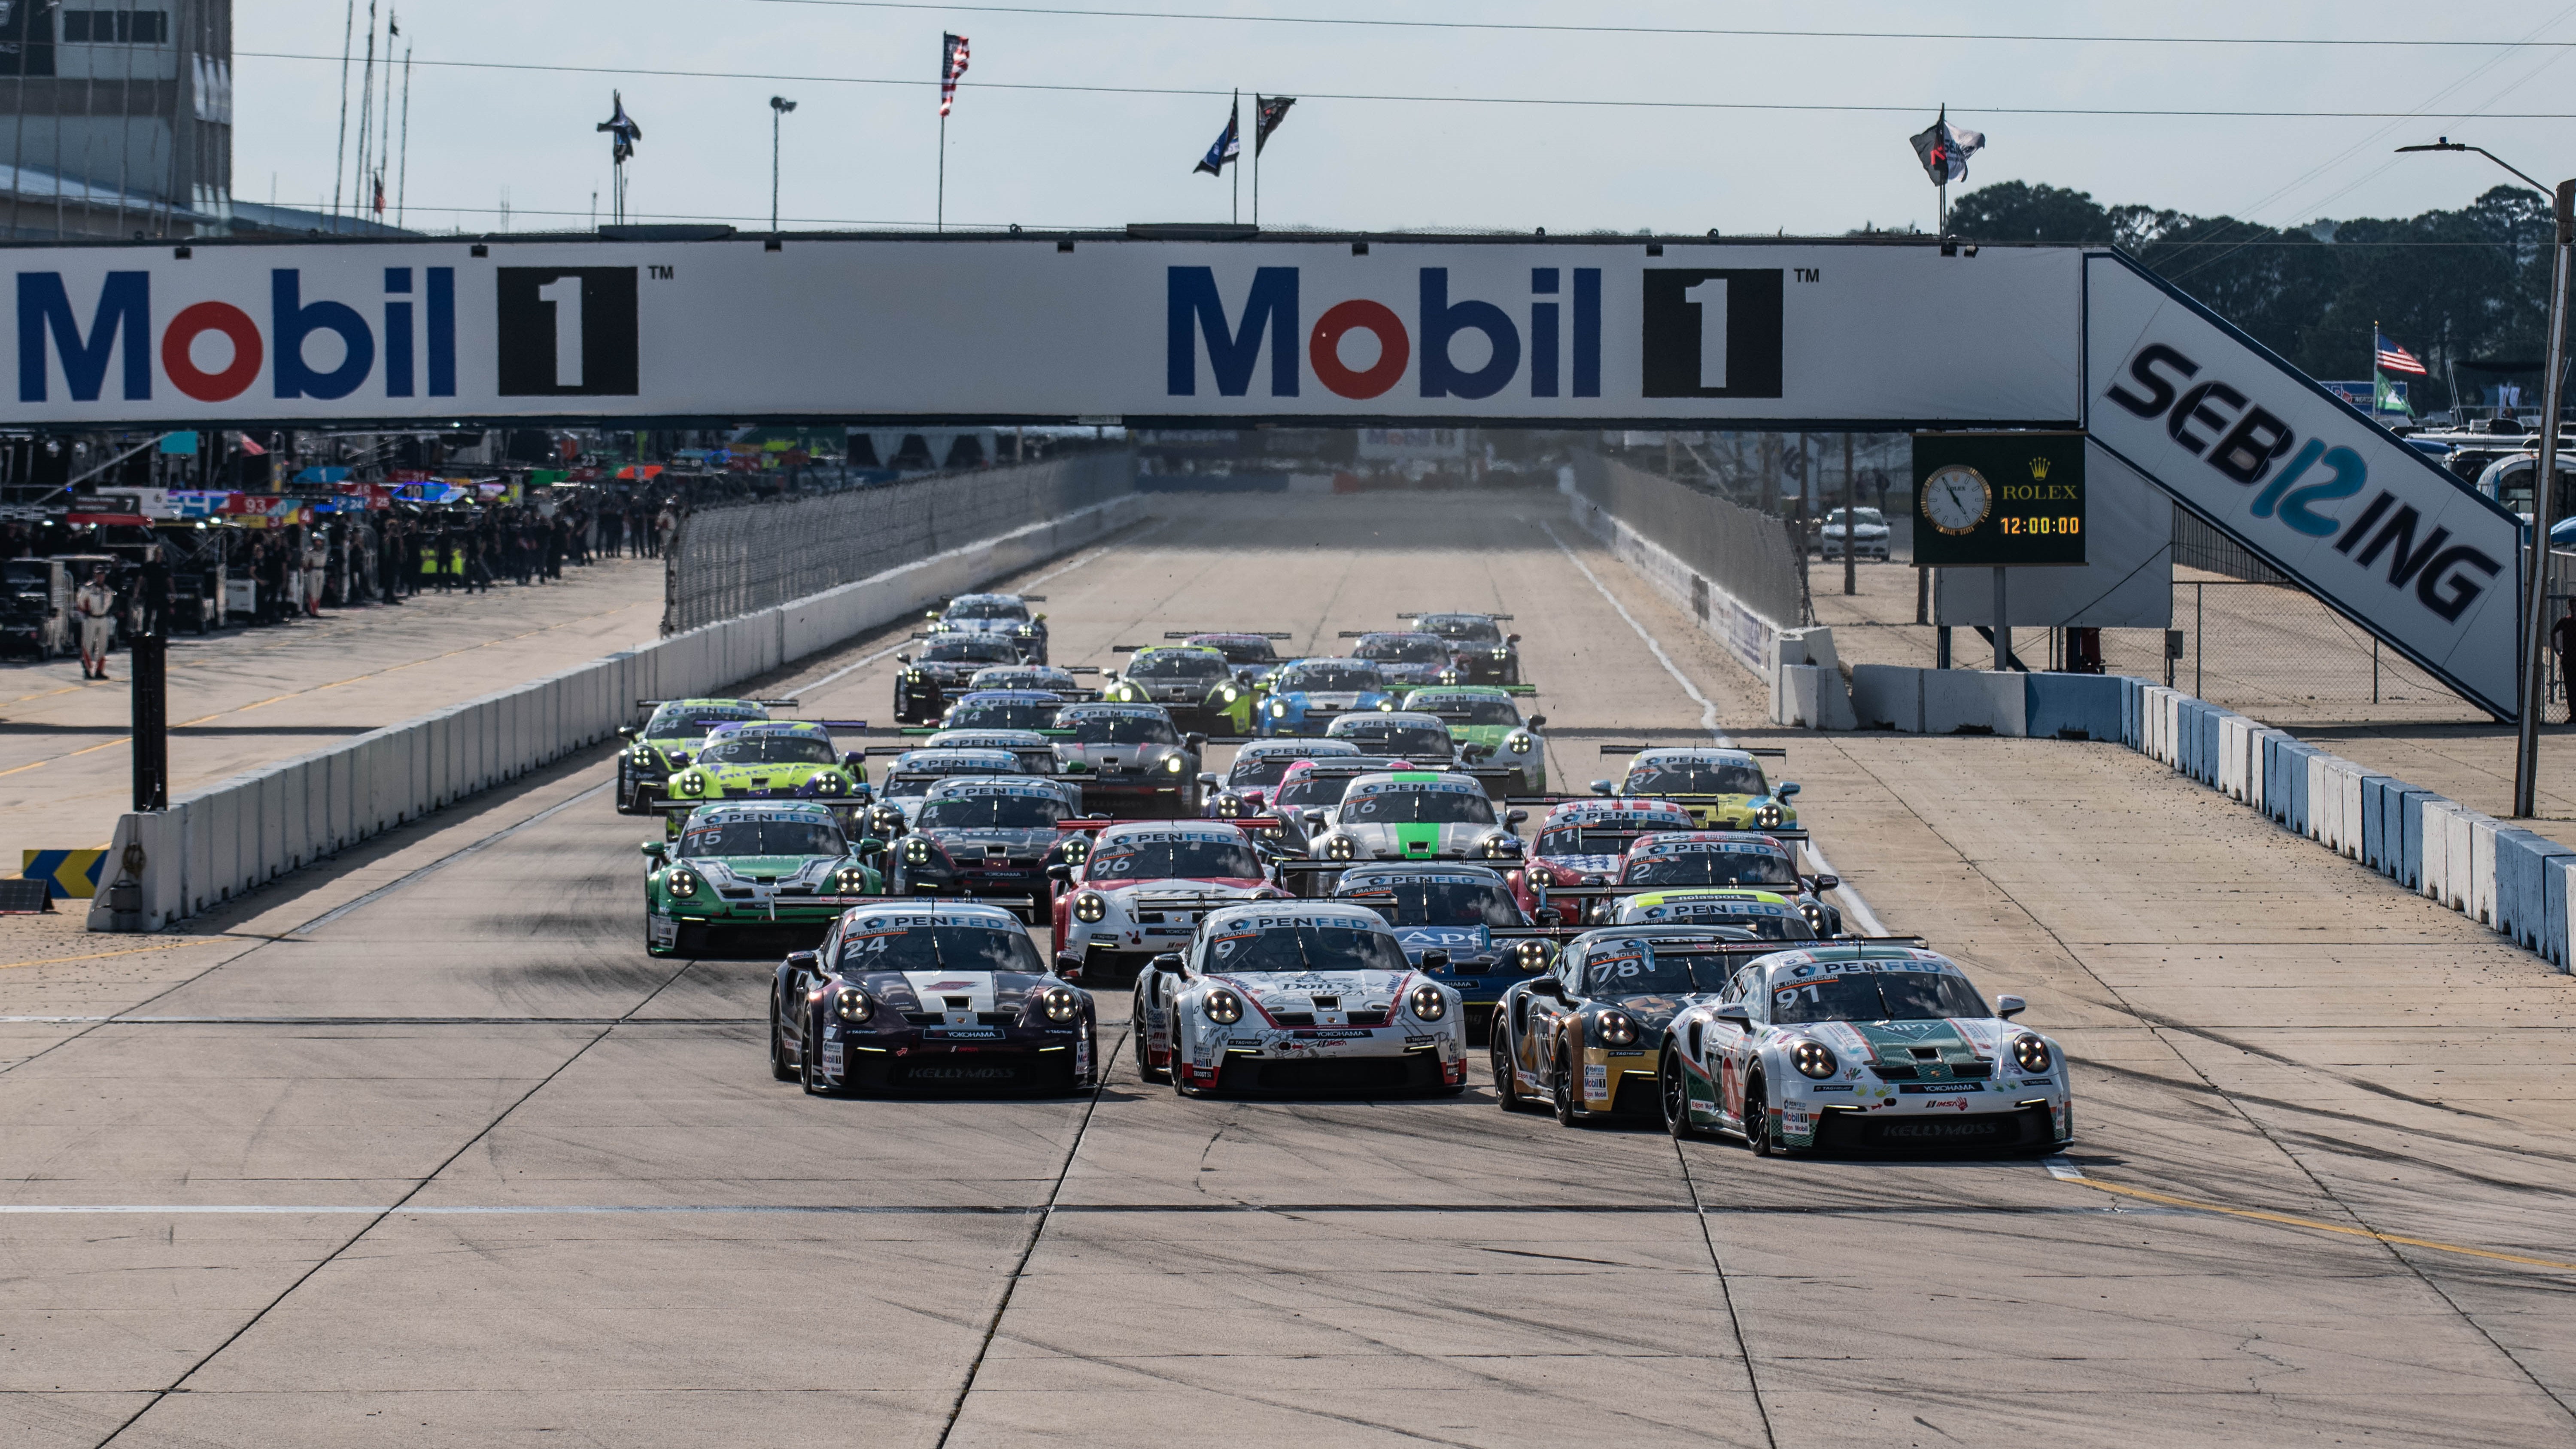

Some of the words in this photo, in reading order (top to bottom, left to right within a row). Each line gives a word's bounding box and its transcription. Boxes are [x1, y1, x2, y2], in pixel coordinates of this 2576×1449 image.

[649, 267, 673, 280] TM
[1794, 269, 1820, 283] TM
[16, 266, 457, 403] Mobil
[538, 276, 583, 387] 1
[1166, 267, 1601, 400] Mobil
[1685, 278, 1728, 389] 1
[2002, 486, 2078, 500] ROLEX
[244, 499, 266, 513] 93
[2001, 517, 2079, 534] 12:00:00
[928, 759, 1007, 769] PENFED
[1666, 757, 1744, 766] PENFED
[965, 787, 1050, 798] PENFED
[1385, 784, 1469, 793] PENFED
[923, 806, 940, 819] 4
[1345, 800, 1377, 816] 16
[729, 813, 819, 823] PENFED
[1586, 812, 1675, 822] PENFED
[688, 831, 722, 849] 15
[1138, 833, 1231, 843] PENFED
[1103, 849, 1135, 858] THOMAS
[1675, 843, 1770, 854] PENFED
[1094, 857, 1130, 876] 96
[1634, 864, 1651, 880] 2
[1392, 876, 1476, 884] PENFED
[1675, 905, 1782, 915] PENFED
[894, 916, 1004, 929] PENFED
[1259, 917, 1368, 929] PENFED
[856, 927, 909, 936] JEANSONNE
[1225, 930, 1257, 938] VANIER
[844, 936, 889, 961] 24
[1216, 940, 1236, 959] 9
[1601, 951, 1642, 962] YADLEY
[1593, 960, 1639, 983] 78
[1825, 960, 1942, 973] PENFED
[1784, 974, 1839, 986] DICKINSON
[1777, 985, 1820, 1009] 91
[823, 1054, 835, 1063] Mobil
[1193, 1057, 1206, 1067] Mobil
[1585, 1078, 1598, 1088] Mobil
[1783, 1111, 1799, 1123] Mobil
